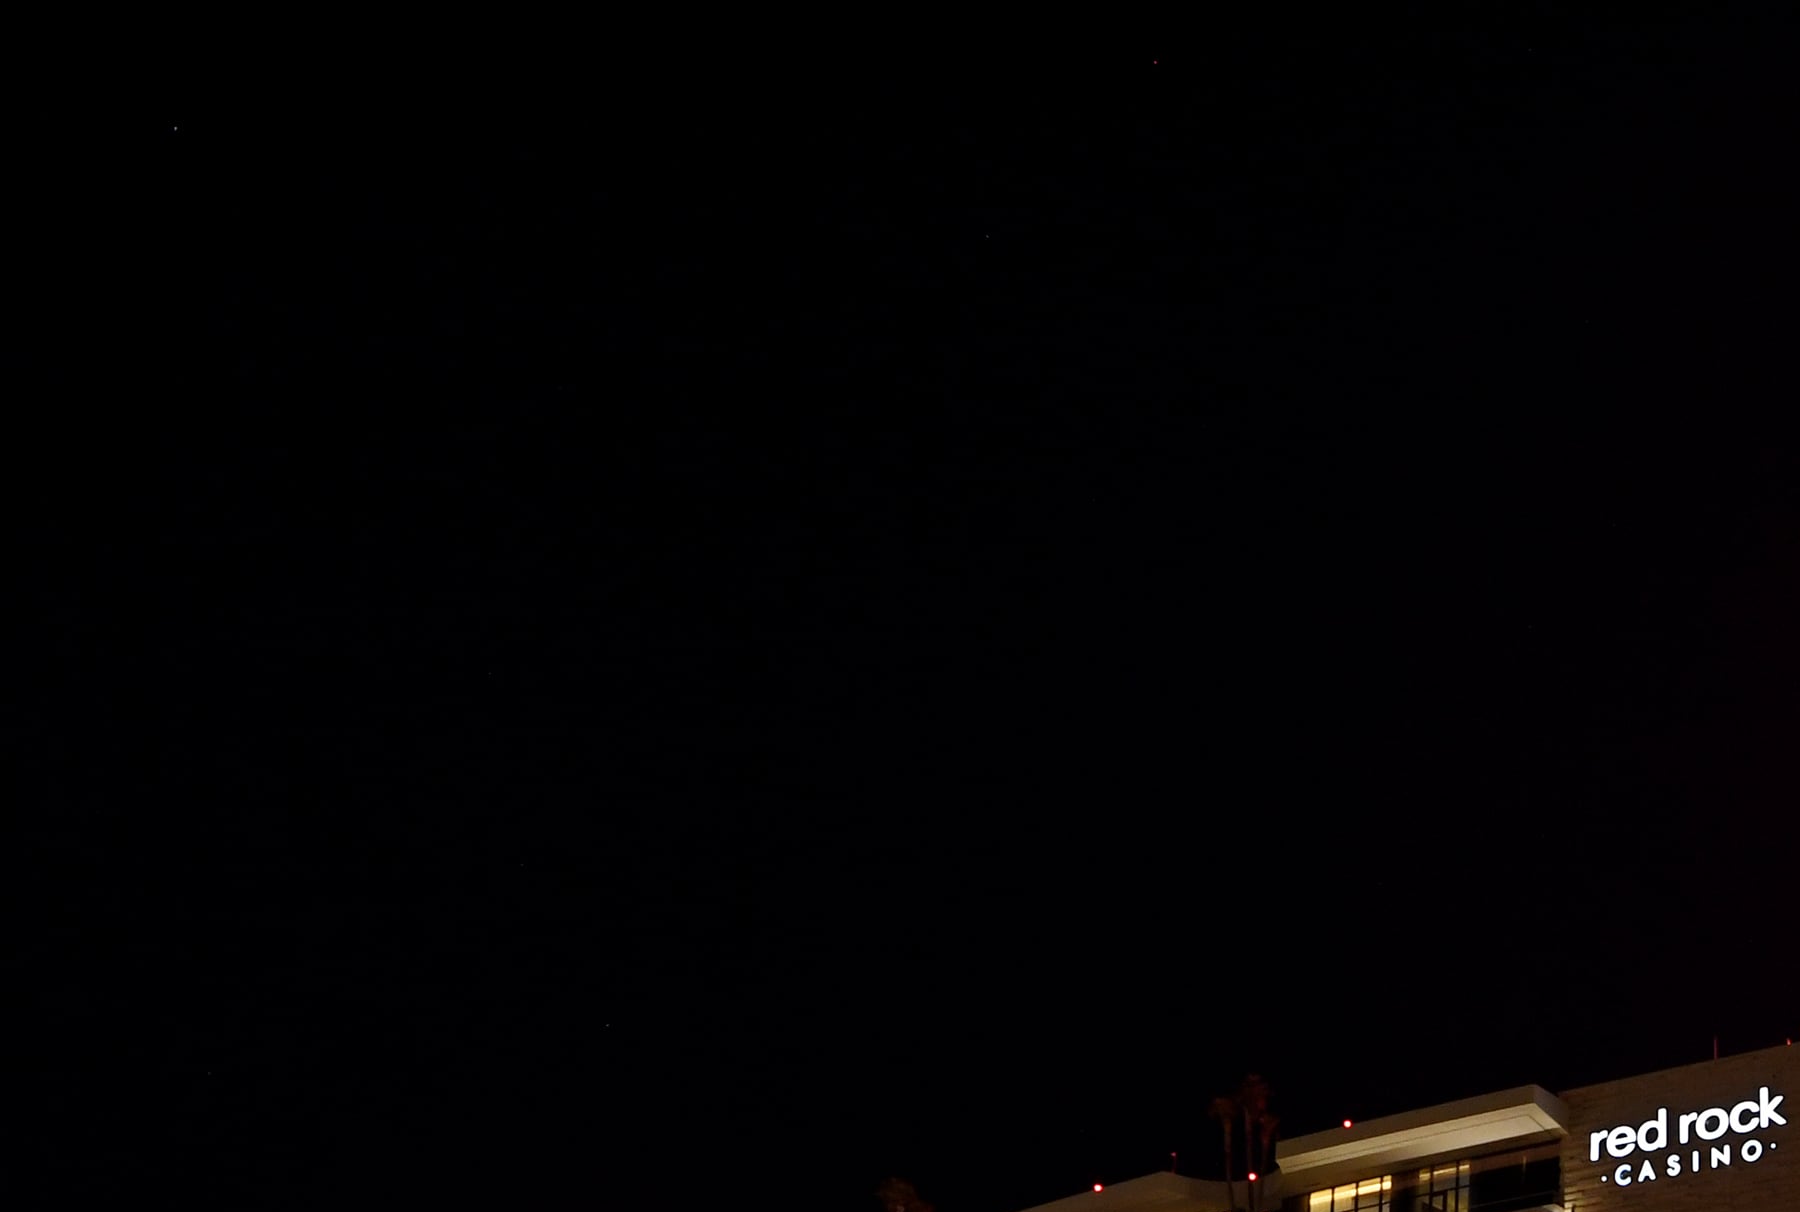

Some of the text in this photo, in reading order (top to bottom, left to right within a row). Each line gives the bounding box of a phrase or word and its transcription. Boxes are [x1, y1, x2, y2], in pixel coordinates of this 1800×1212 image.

[1589, 1086, 1787, 1162] red rock
[1614, 1139, 1763, 1187] CASINO
